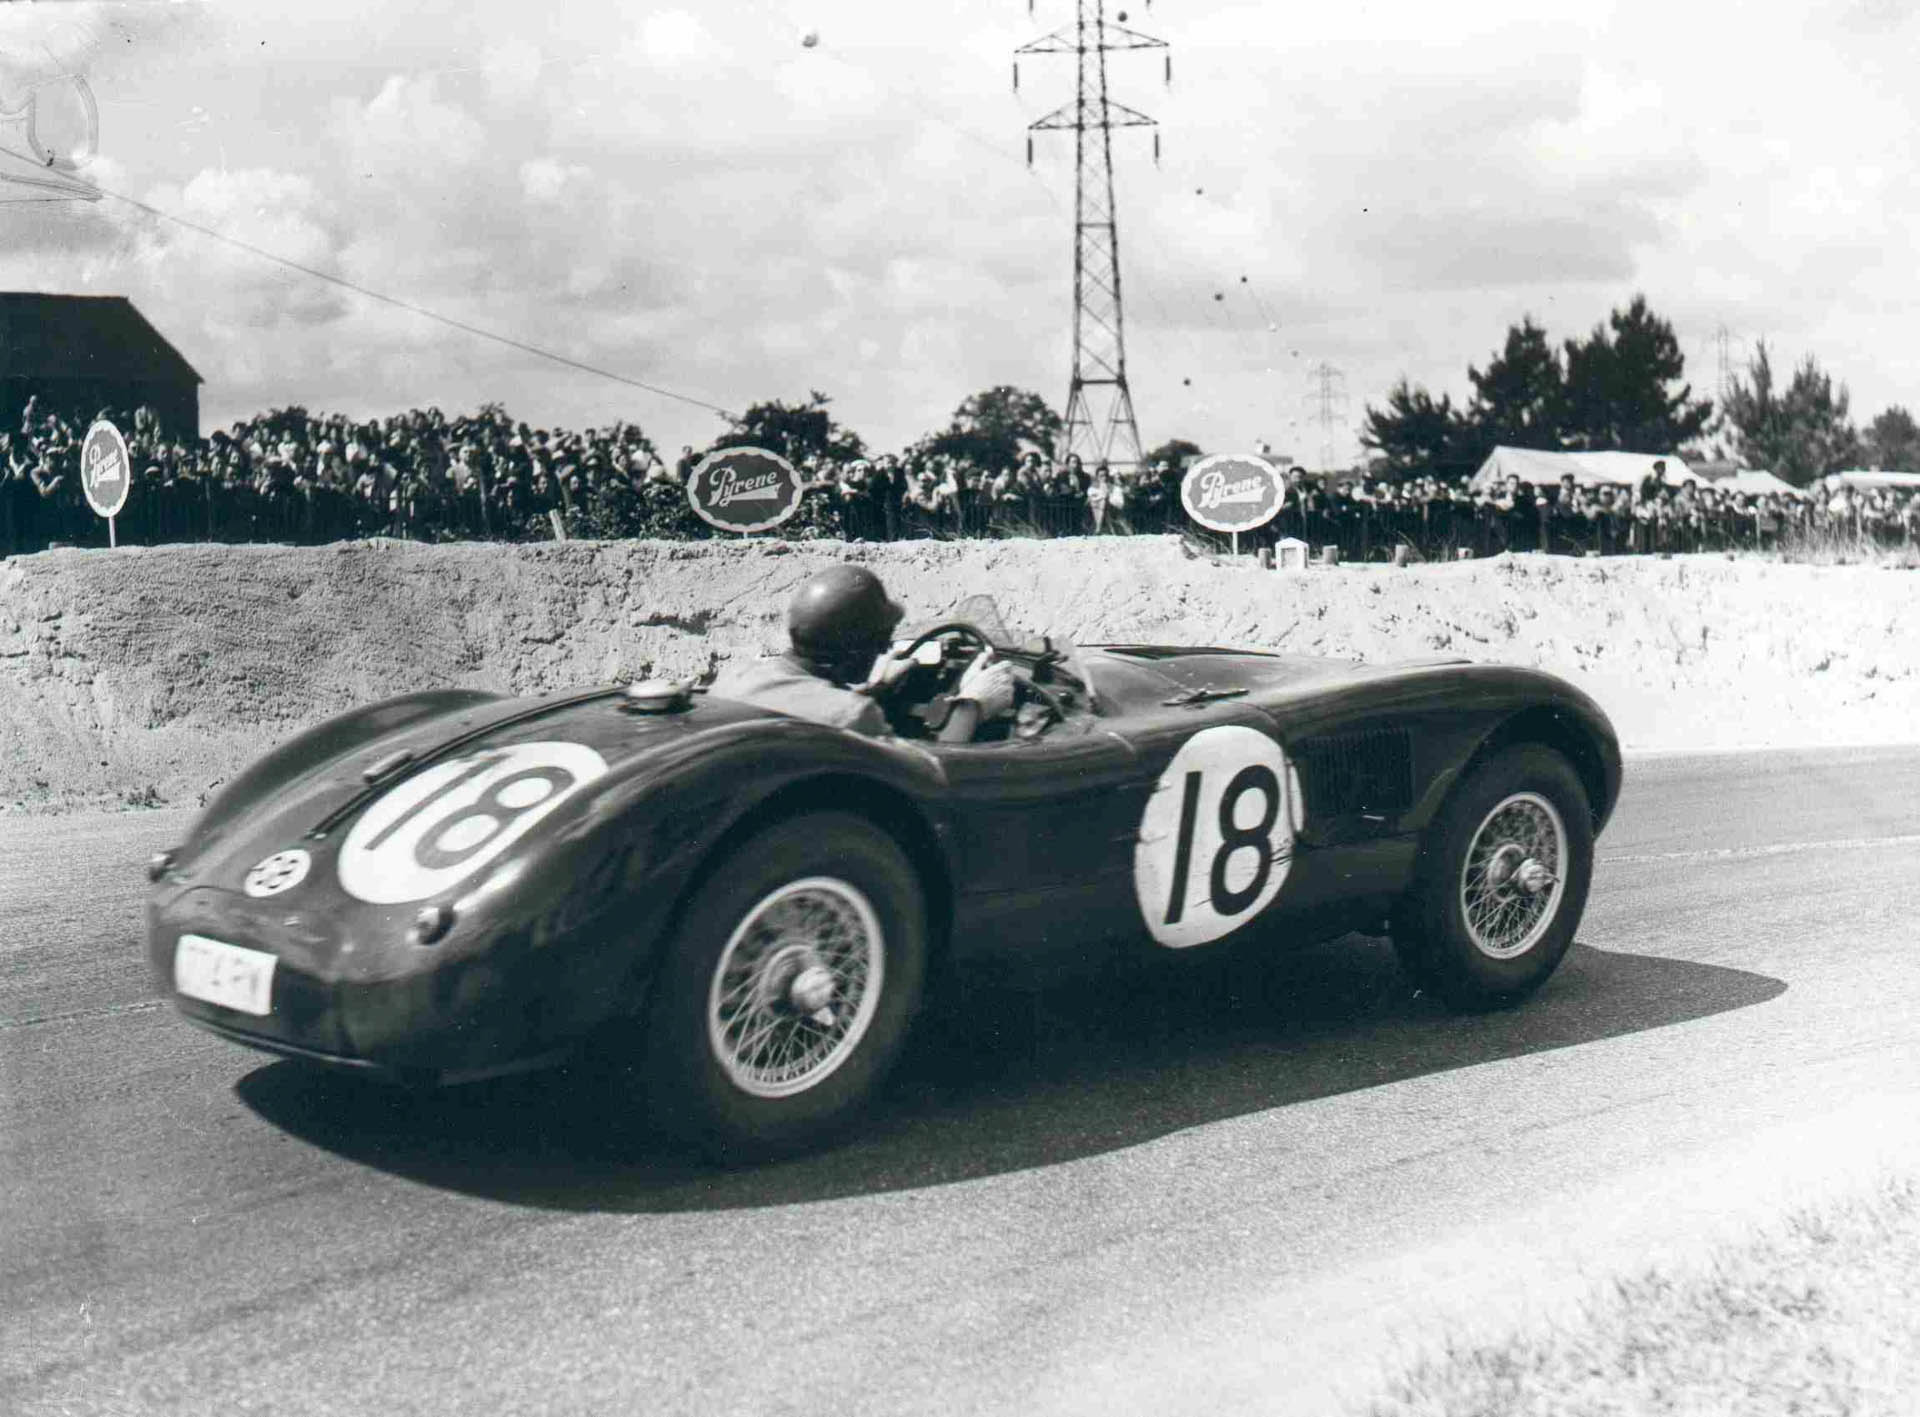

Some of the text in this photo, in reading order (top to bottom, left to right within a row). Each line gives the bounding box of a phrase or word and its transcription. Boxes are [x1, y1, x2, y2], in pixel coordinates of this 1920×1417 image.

[707, 465, 783, 507] Pyrene
[364, 752, 576, 870] 18
[1163, 764, 1280, 925] 18
